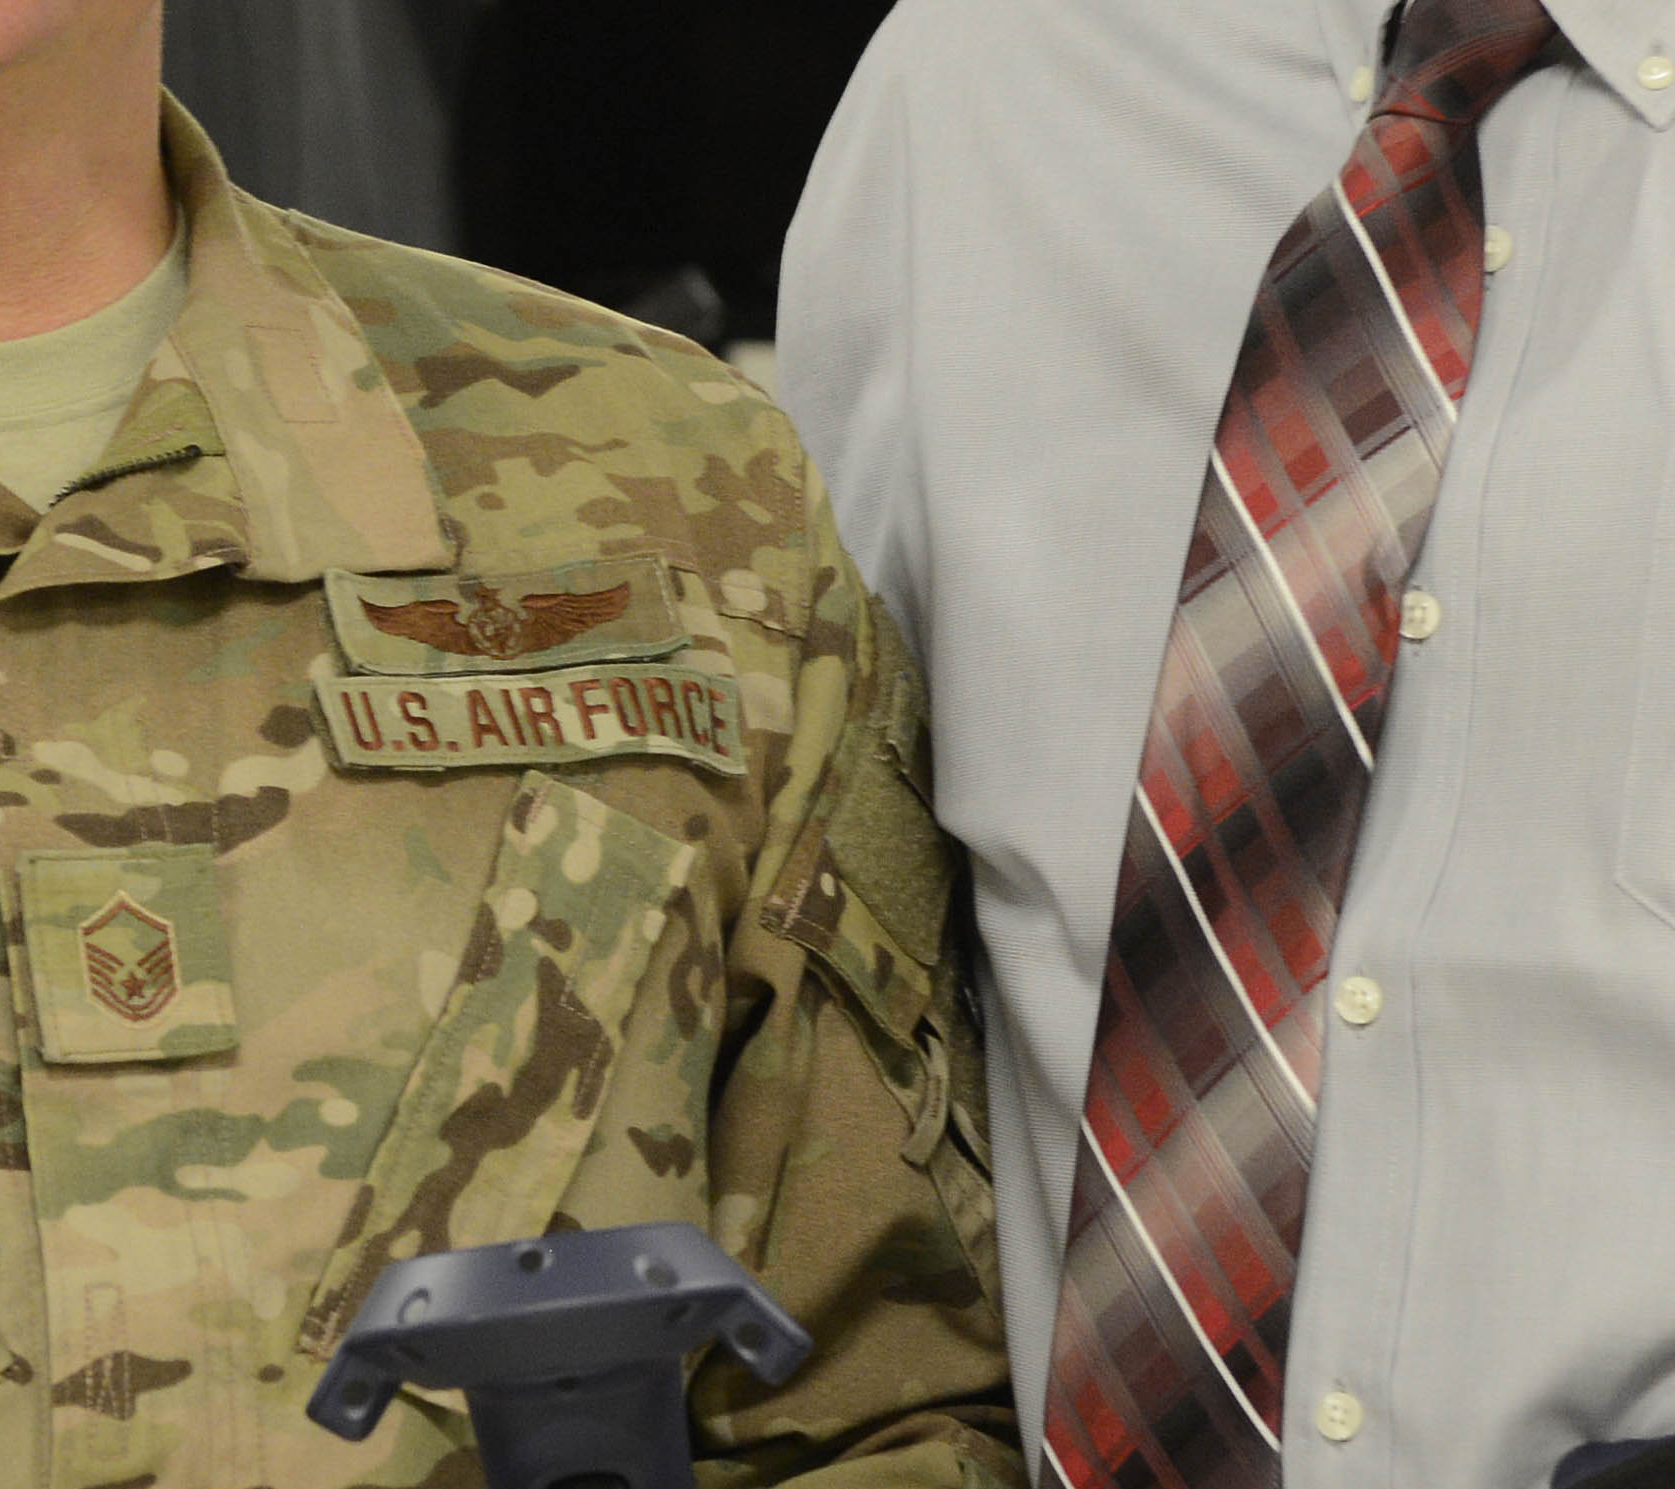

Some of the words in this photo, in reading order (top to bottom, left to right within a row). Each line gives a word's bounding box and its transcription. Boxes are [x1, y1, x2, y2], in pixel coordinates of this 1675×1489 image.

[339, 689, 459, 754] U.S.
[467, 685, 564, 749] AIR
[570, 676, 731, 758] FORCE
